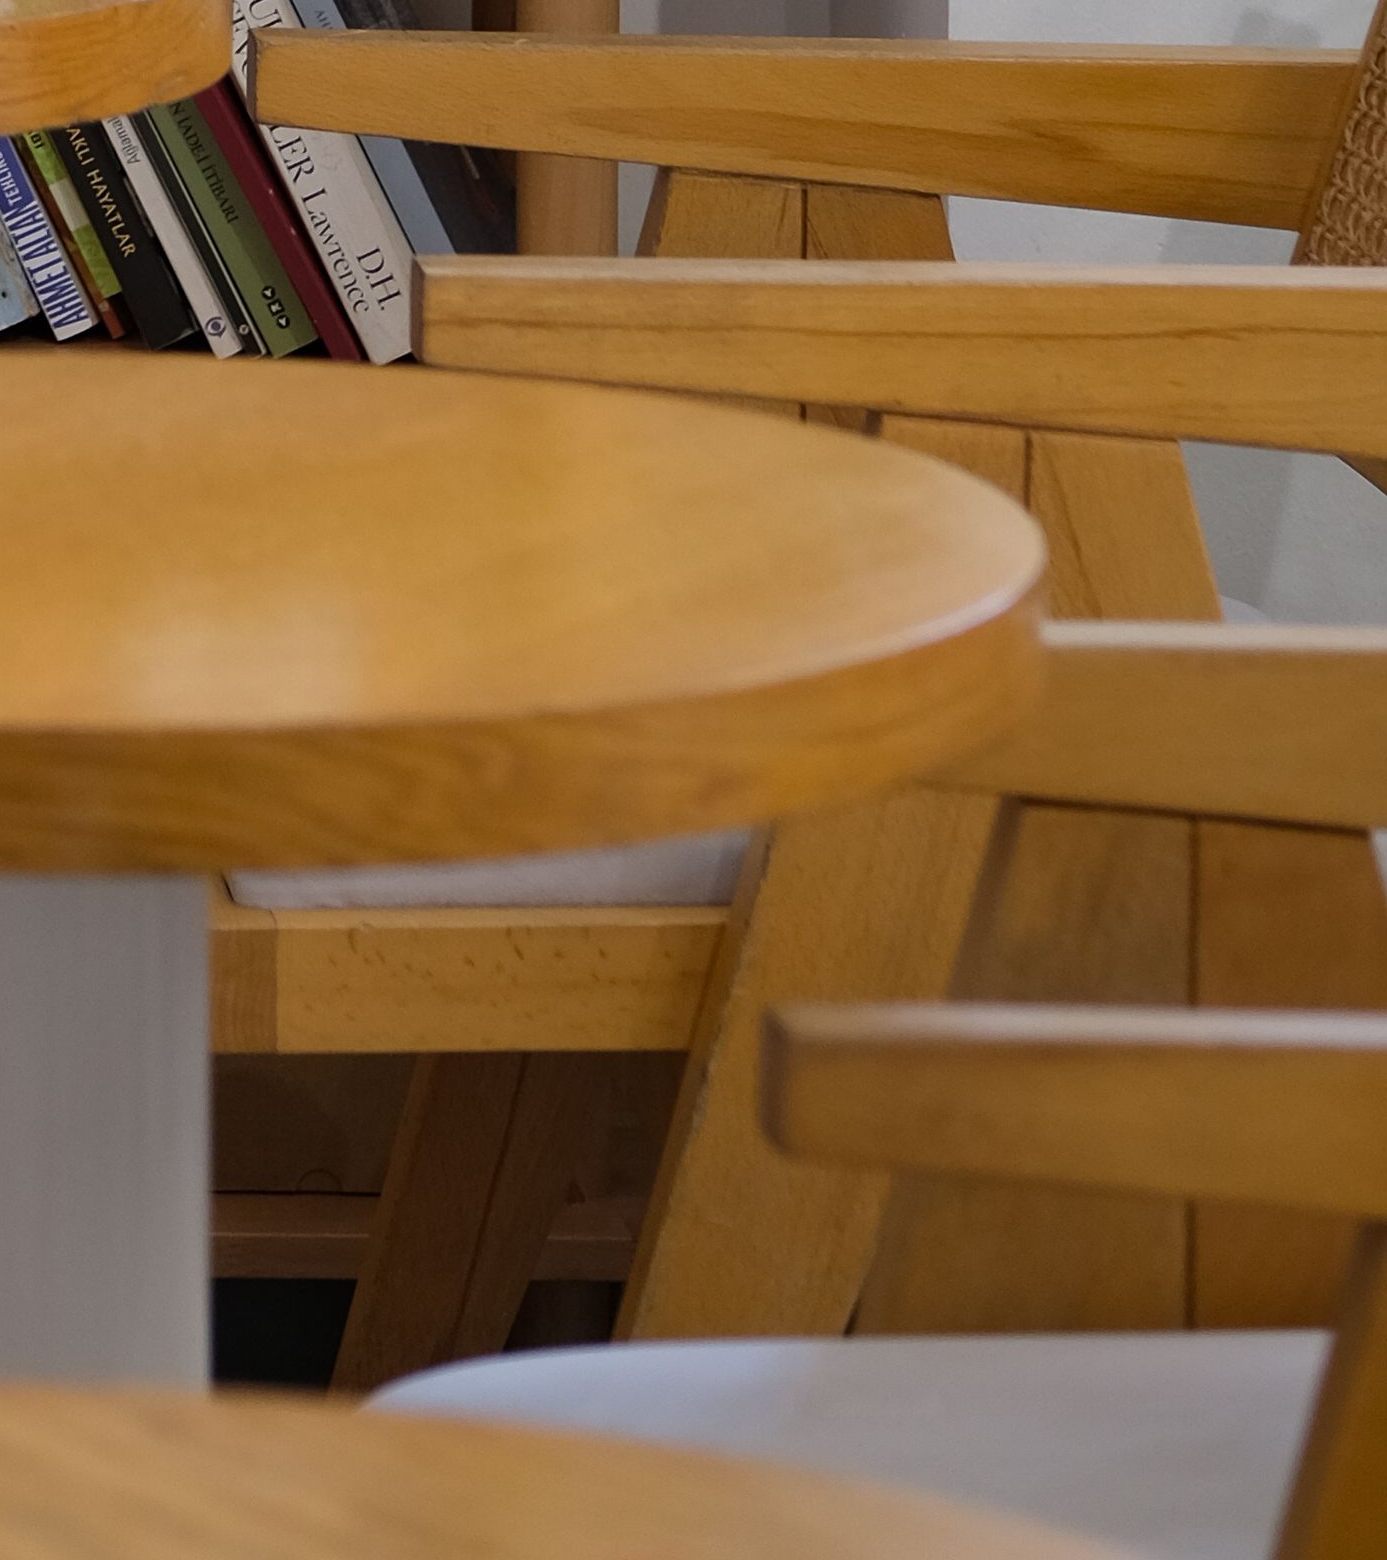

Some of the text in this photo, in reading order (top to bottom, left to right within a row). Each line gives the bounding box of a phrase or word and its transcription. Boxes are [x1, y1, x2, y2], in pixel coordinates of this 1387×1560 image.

[86, 169, 137, 259] HAYATLAR
[301, 187, 371, 314] Lawrence
[356, 246, 403, 311] D.H.
